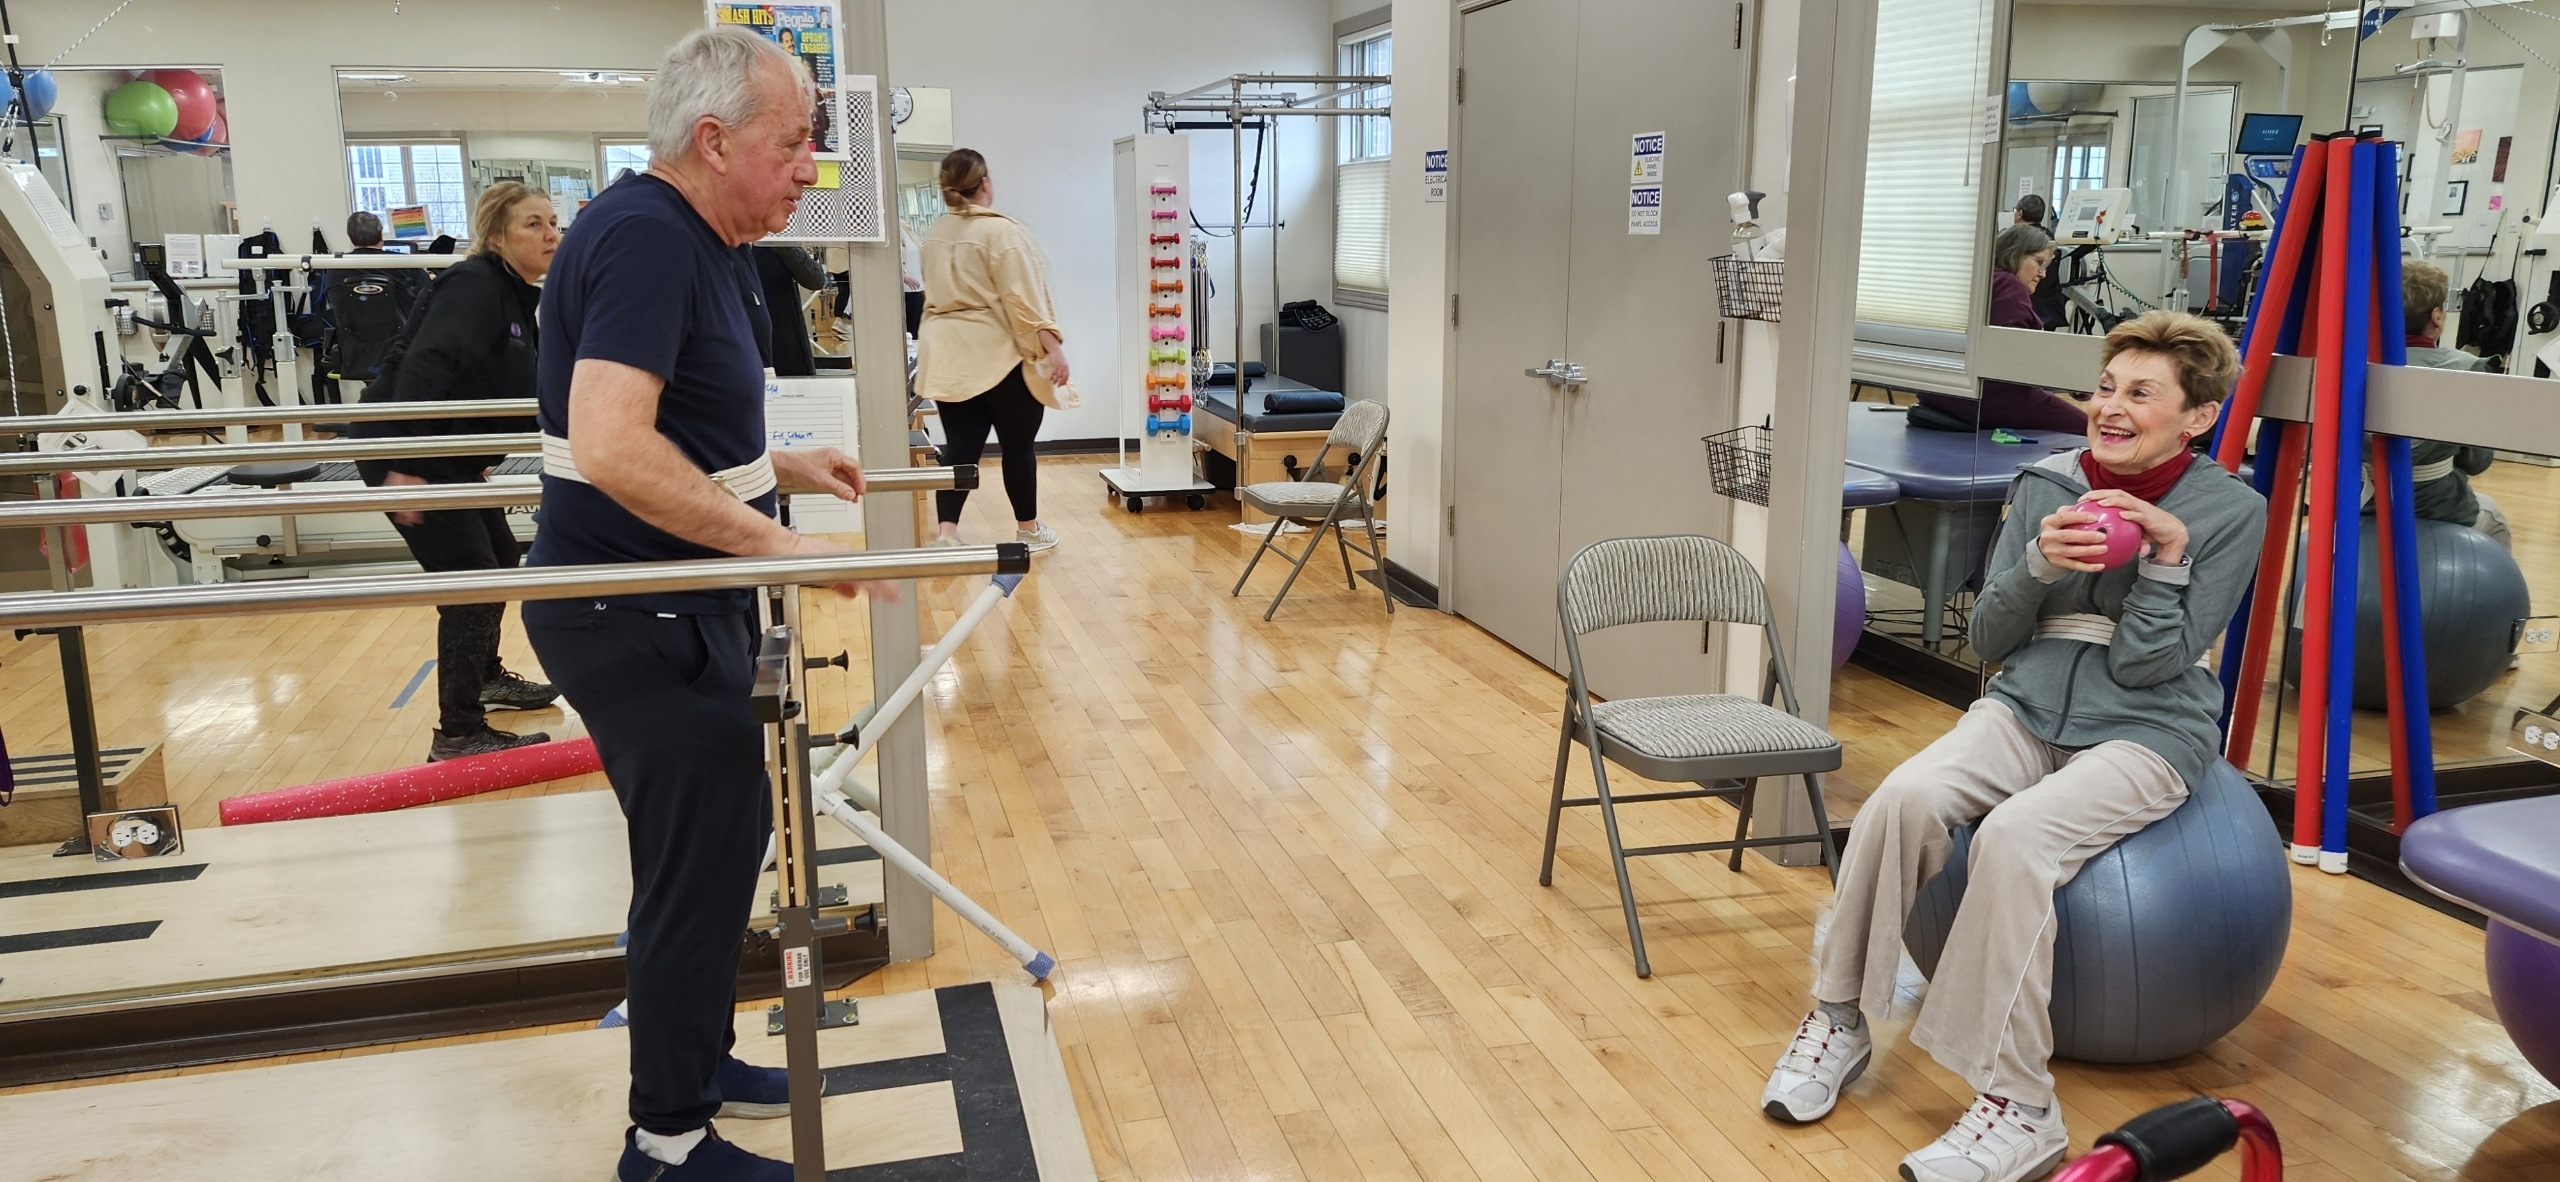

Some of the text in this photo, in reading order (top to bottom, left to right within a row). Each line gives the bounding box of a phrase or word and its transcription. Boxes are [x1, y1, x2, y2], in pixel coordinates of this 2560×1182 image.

[752, 9, 774, 25] HITS
[776, 11, 815, 30] People
[1635, 138, 1662, 153] NOTICE
[1427, 154, 1447, 168] NOTICE
[1425, 175, 1447, 184] ELECTRICA
[1632, 191, 1660, 204] NOTICE
